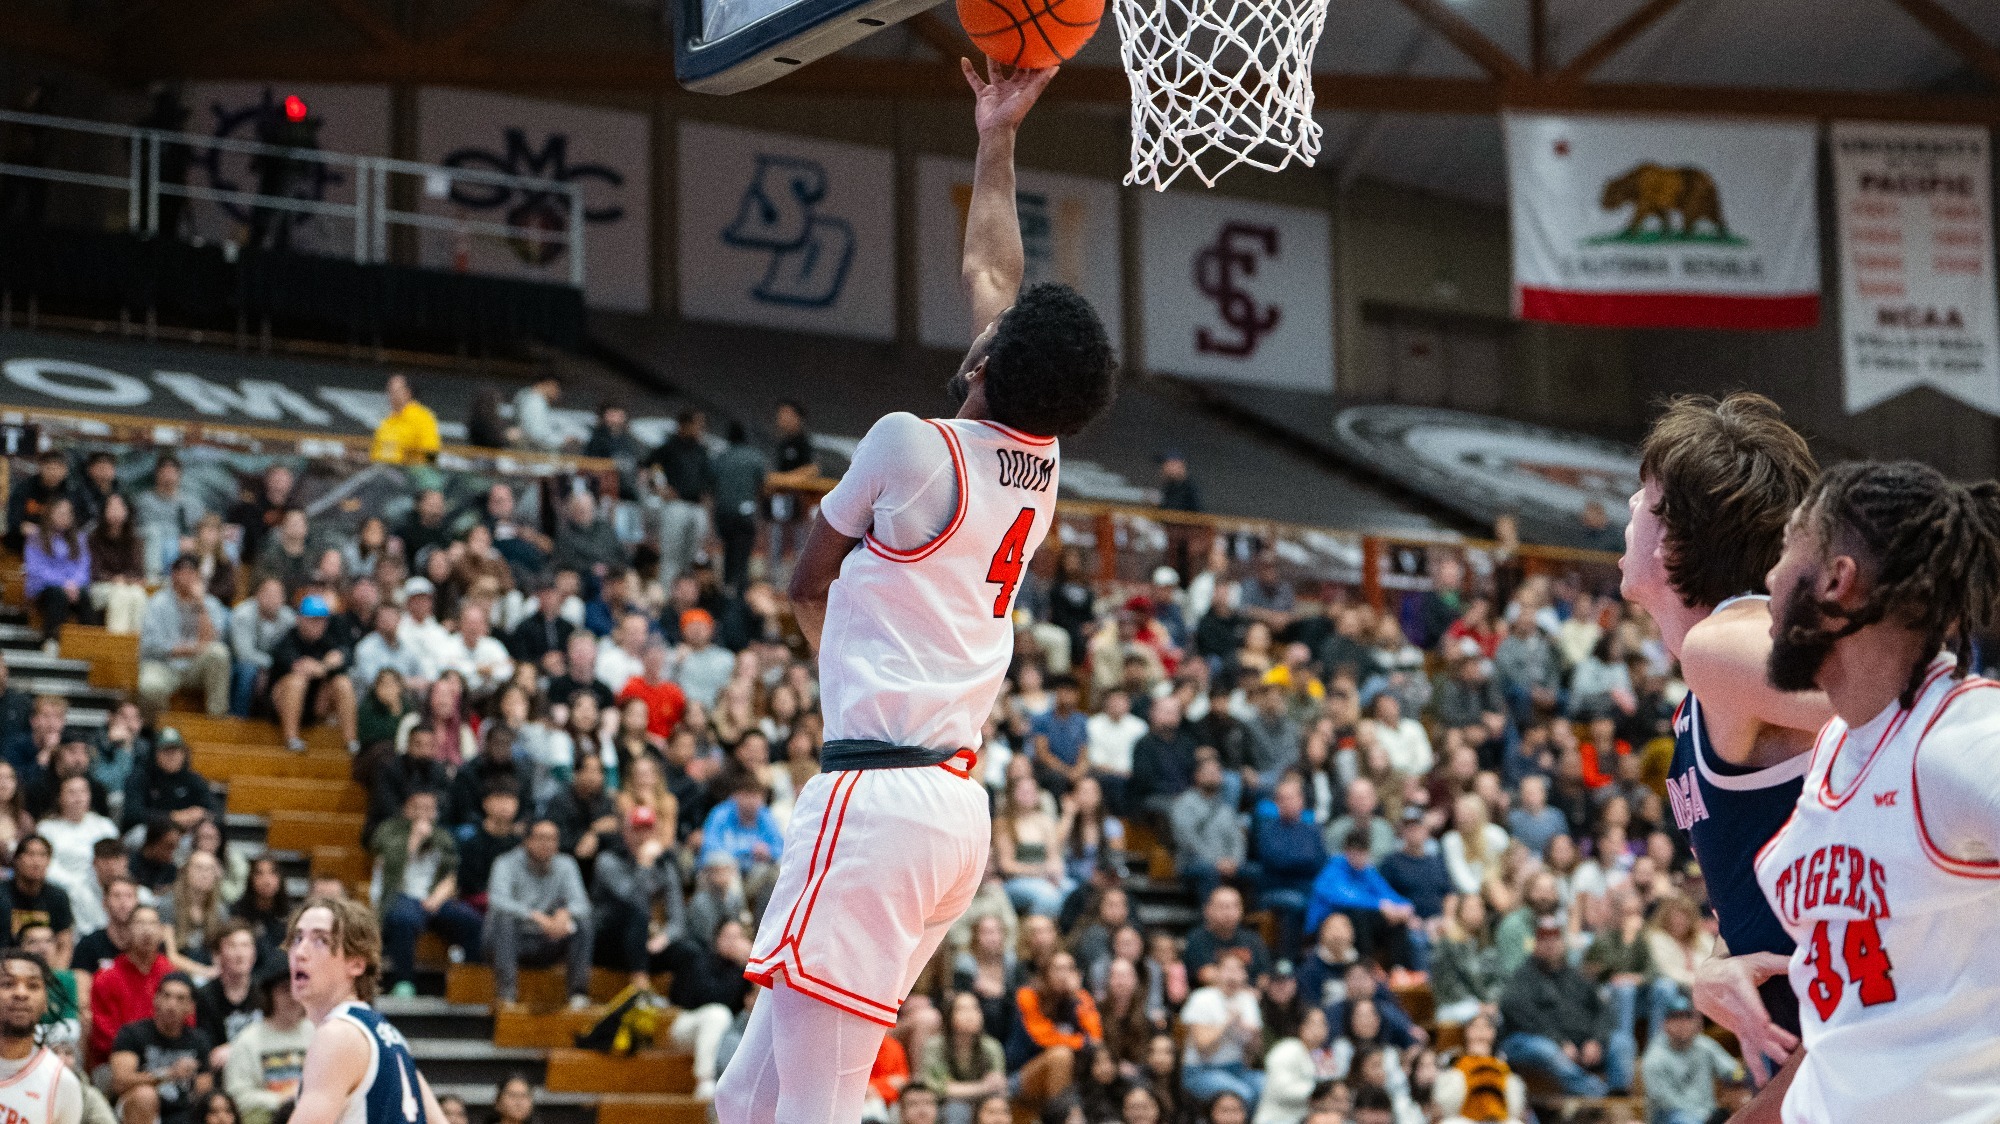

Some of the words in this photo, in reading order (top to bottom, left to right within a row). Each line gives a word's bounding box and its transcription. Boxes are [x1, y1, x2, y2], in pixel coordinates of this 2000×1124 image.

[996, 448, 1056, 493] ODUM
[985, 506, 1036, 618] 4
[1776, 844, 1890, 920] TIGERS
